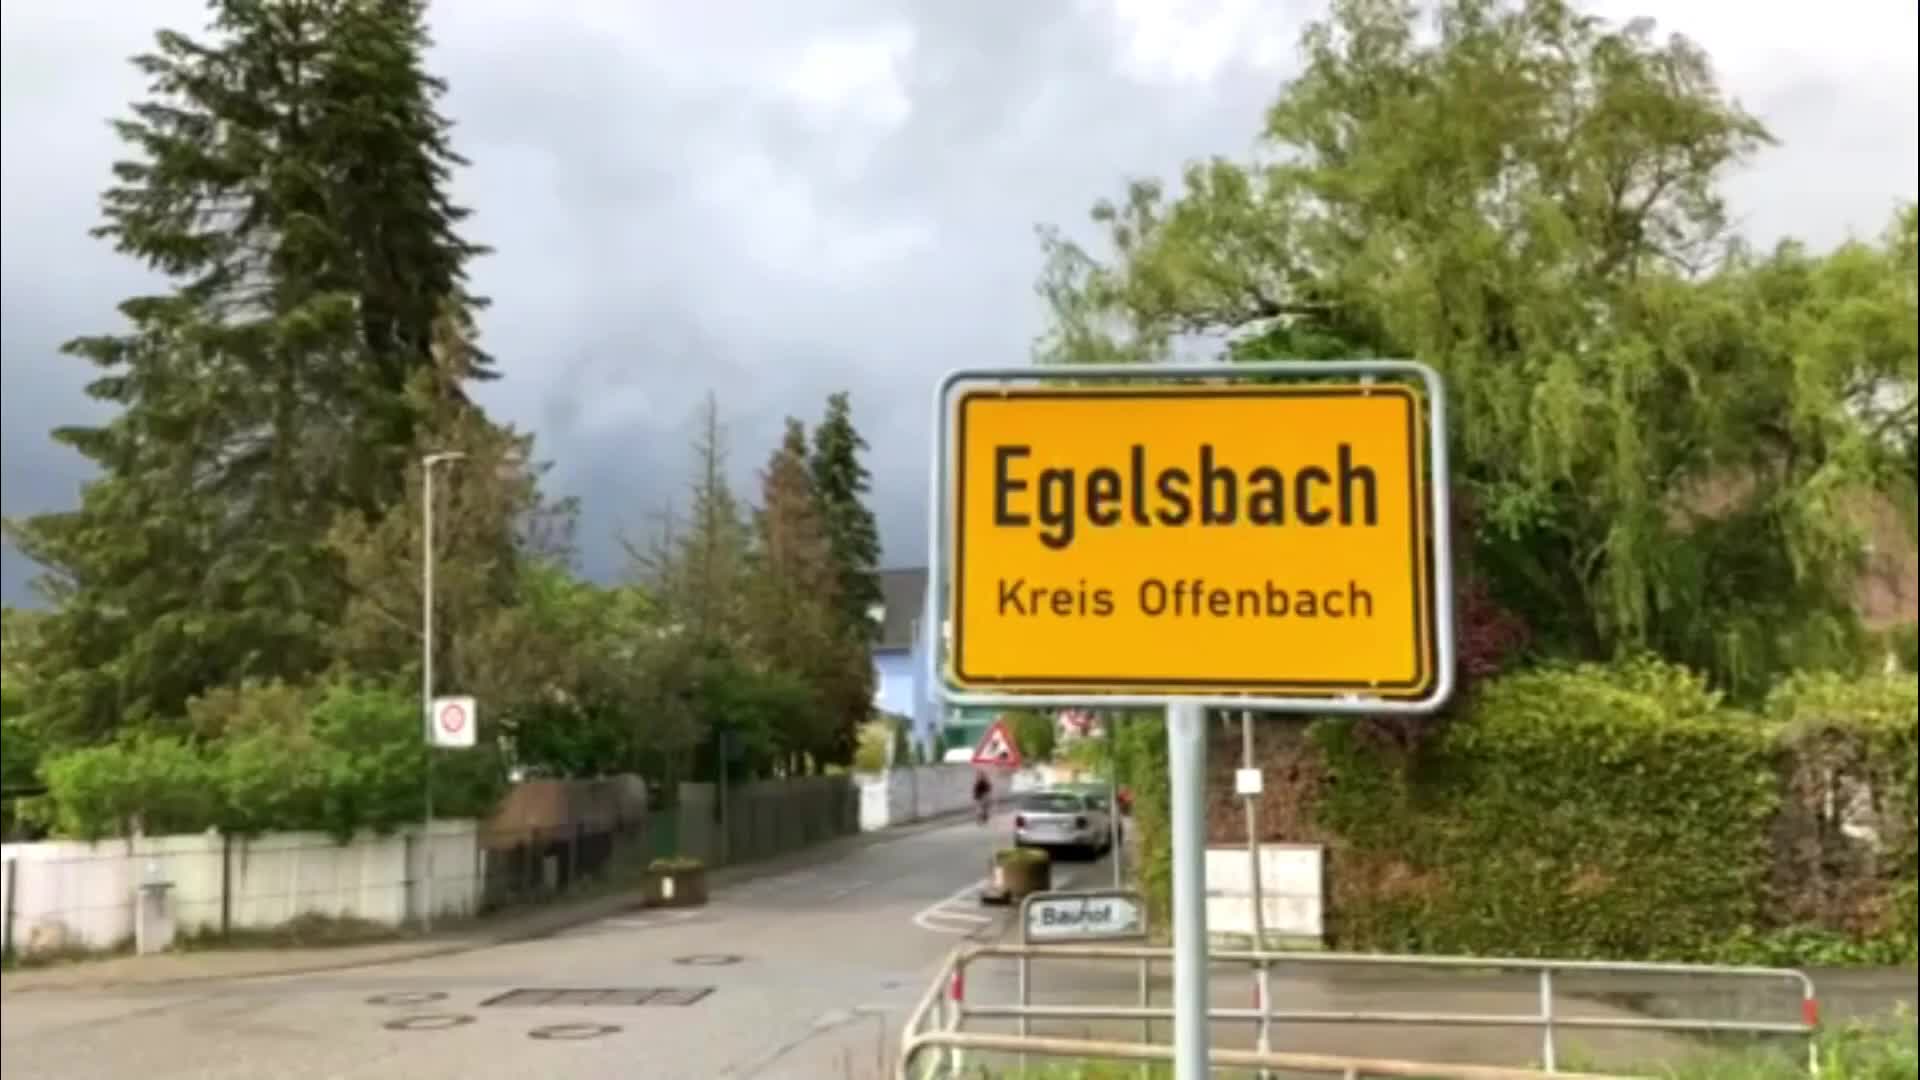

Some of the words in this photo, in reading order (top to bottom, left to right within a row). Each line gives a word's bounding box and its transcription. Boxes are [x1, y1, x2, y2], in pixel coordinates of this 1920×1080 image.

[993, 443, 1379, 549] Egelsbach
[997, 579, 1115, 617] Kreis
[1139, 579, 1374, 618] Offenbach
[1042, 904, 1112, 926] Bauhof
